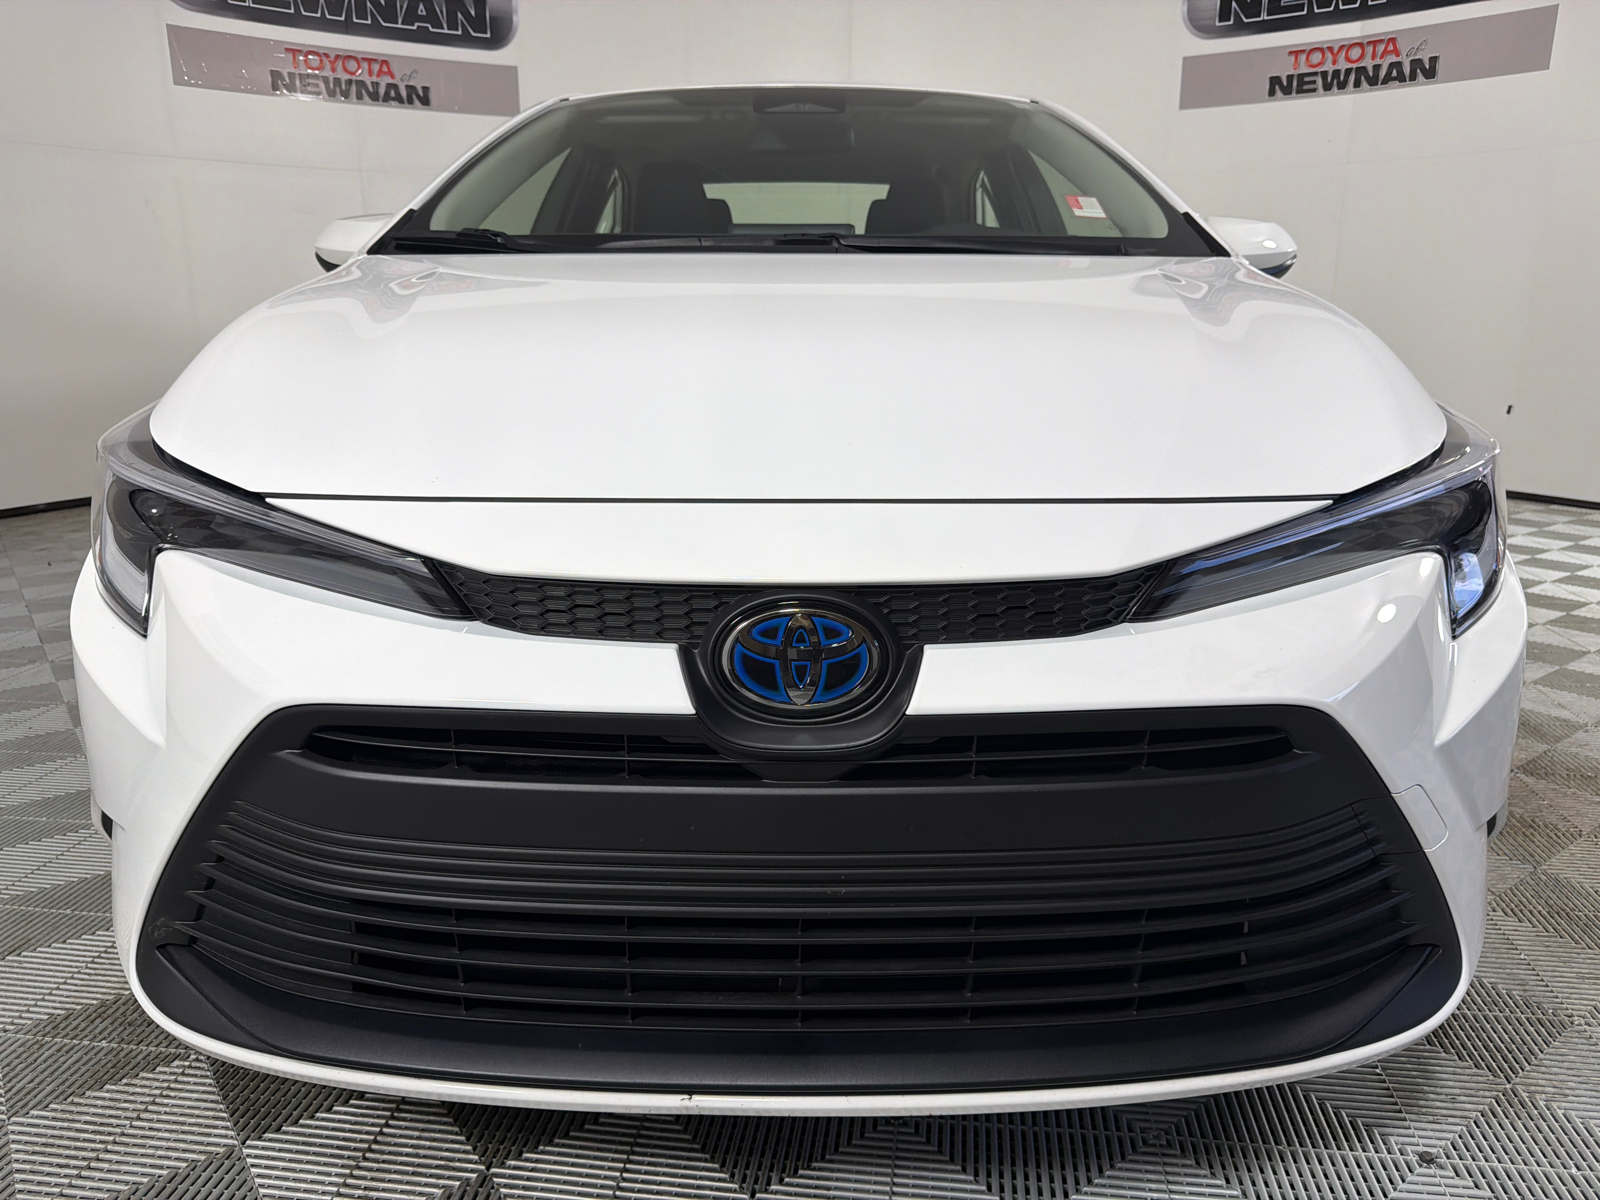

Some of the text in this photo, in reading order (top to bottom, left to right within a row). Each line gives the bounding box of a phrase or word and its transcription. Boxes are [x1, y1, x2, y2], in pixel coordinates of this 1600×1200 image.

[227, 0, 491, 38] WNAN
[284, 47, 419, 83] TOYOTA of
[1287, 36, 1429, 71] TOYOTA of
[269, 69, 431, 107] NEWNAN
[1267, 55, 1440, 98] NEWNAN
